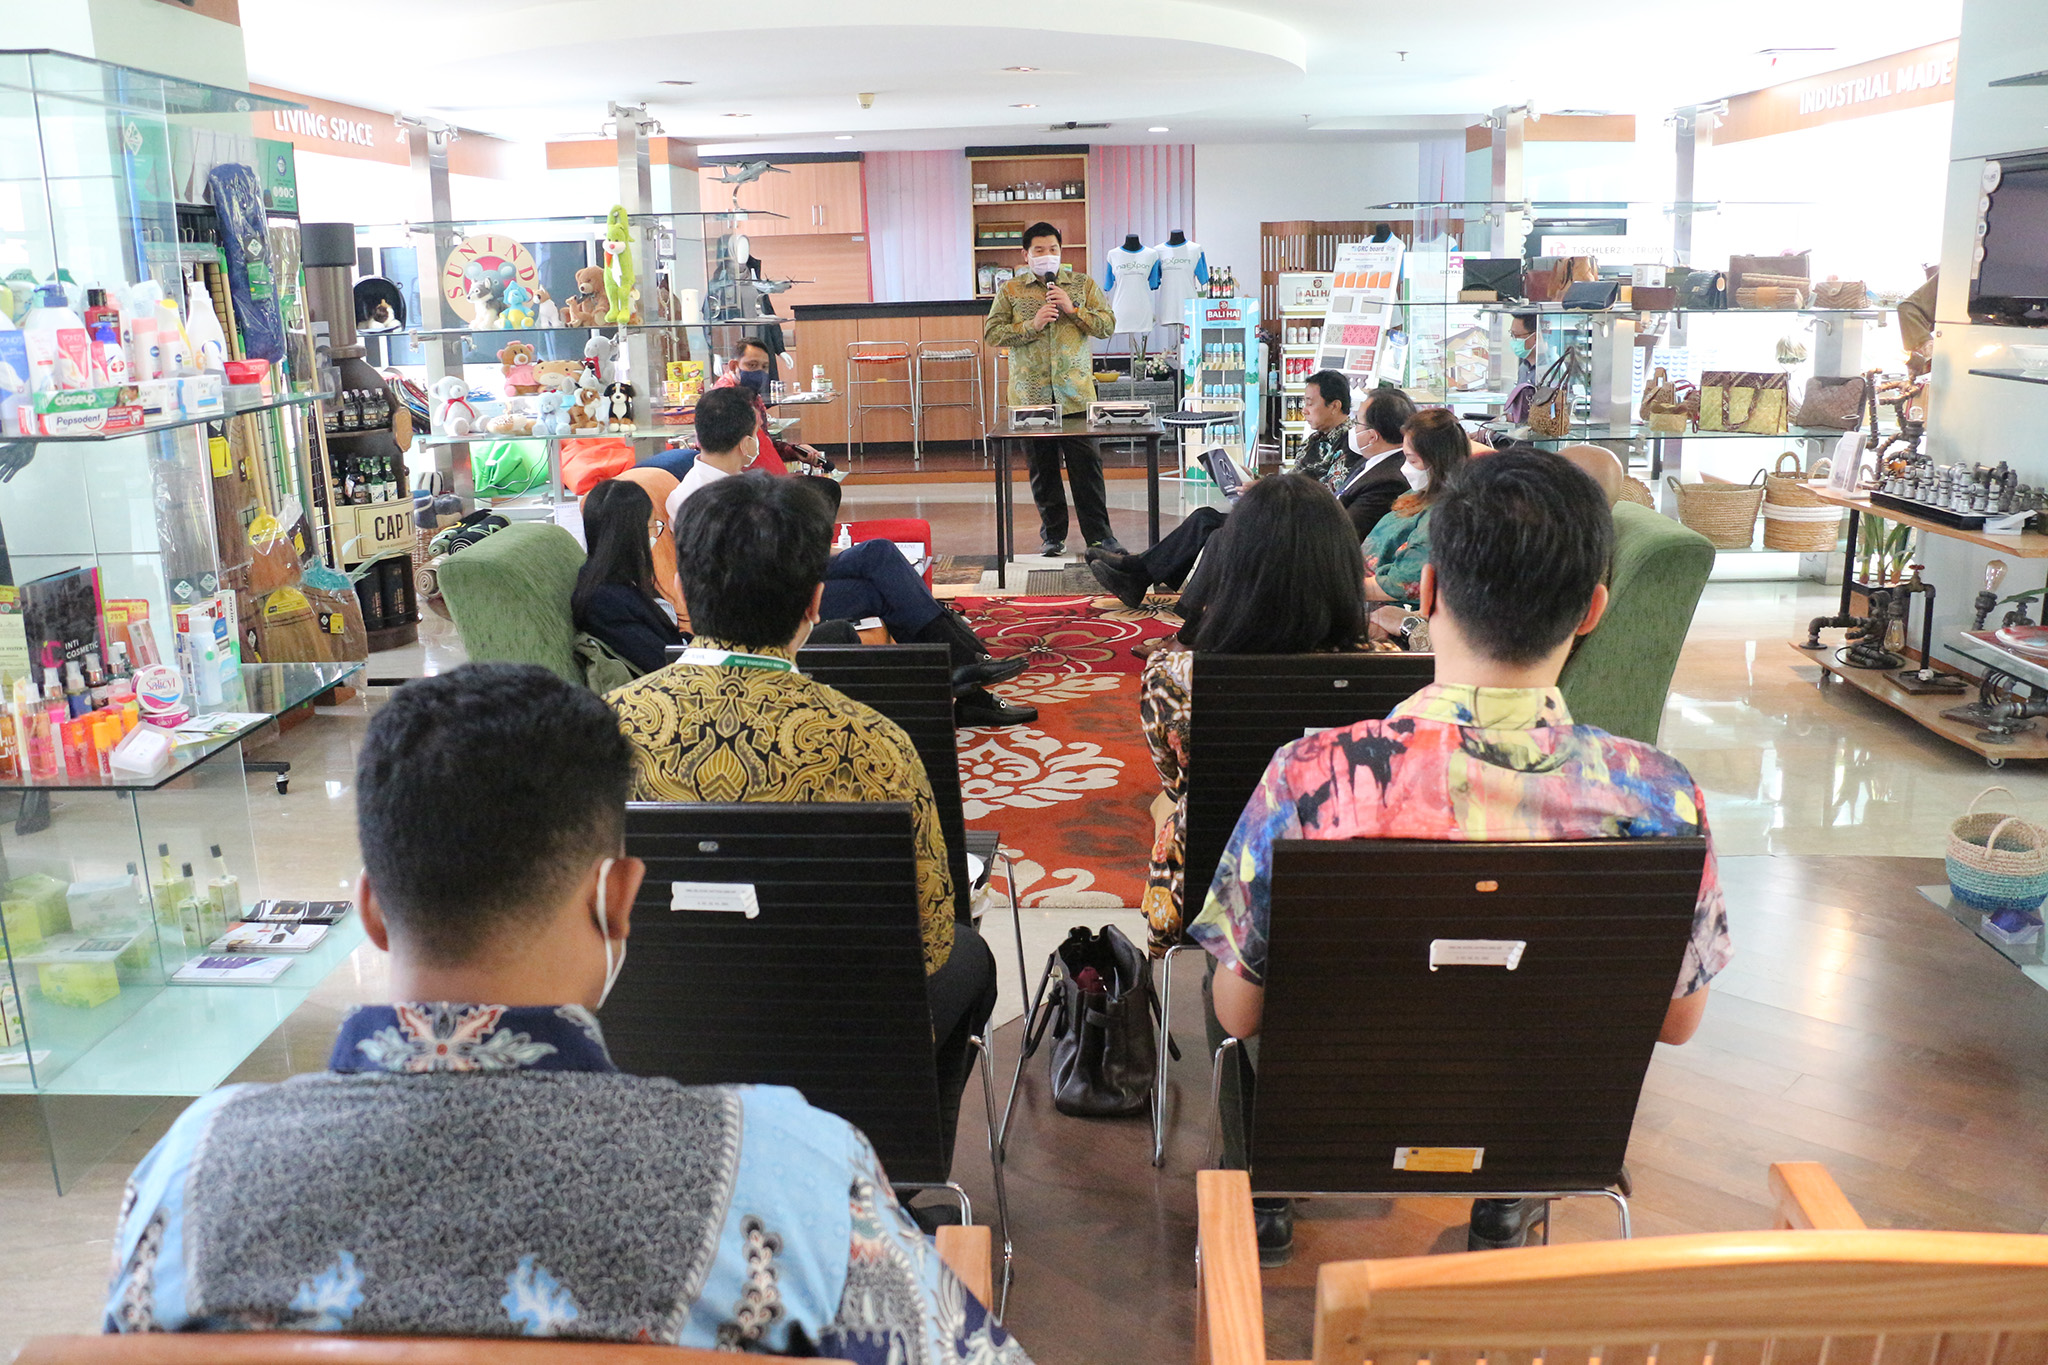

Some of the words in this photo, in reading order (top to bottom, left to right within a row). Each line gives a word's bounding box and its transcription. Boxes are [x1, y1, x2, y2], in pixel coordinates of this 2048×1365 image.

[1800, 71, 1892, 115] INDUSTRIAL
[1896, 57, 1956, 93] MADE
[273, 109, 328, 138] LIVING
[330, 117, 374, 147] SPACE
[55, 392, 96, 406] closeup
[56, 414, 101, 427] Pepsodent
[375, 514, 403, 542] CAP
[65, 639, 80, 650] INTI
[66, 641, 99, 659] COSMETIC
[146, 678, 176, 691] Salicyl
